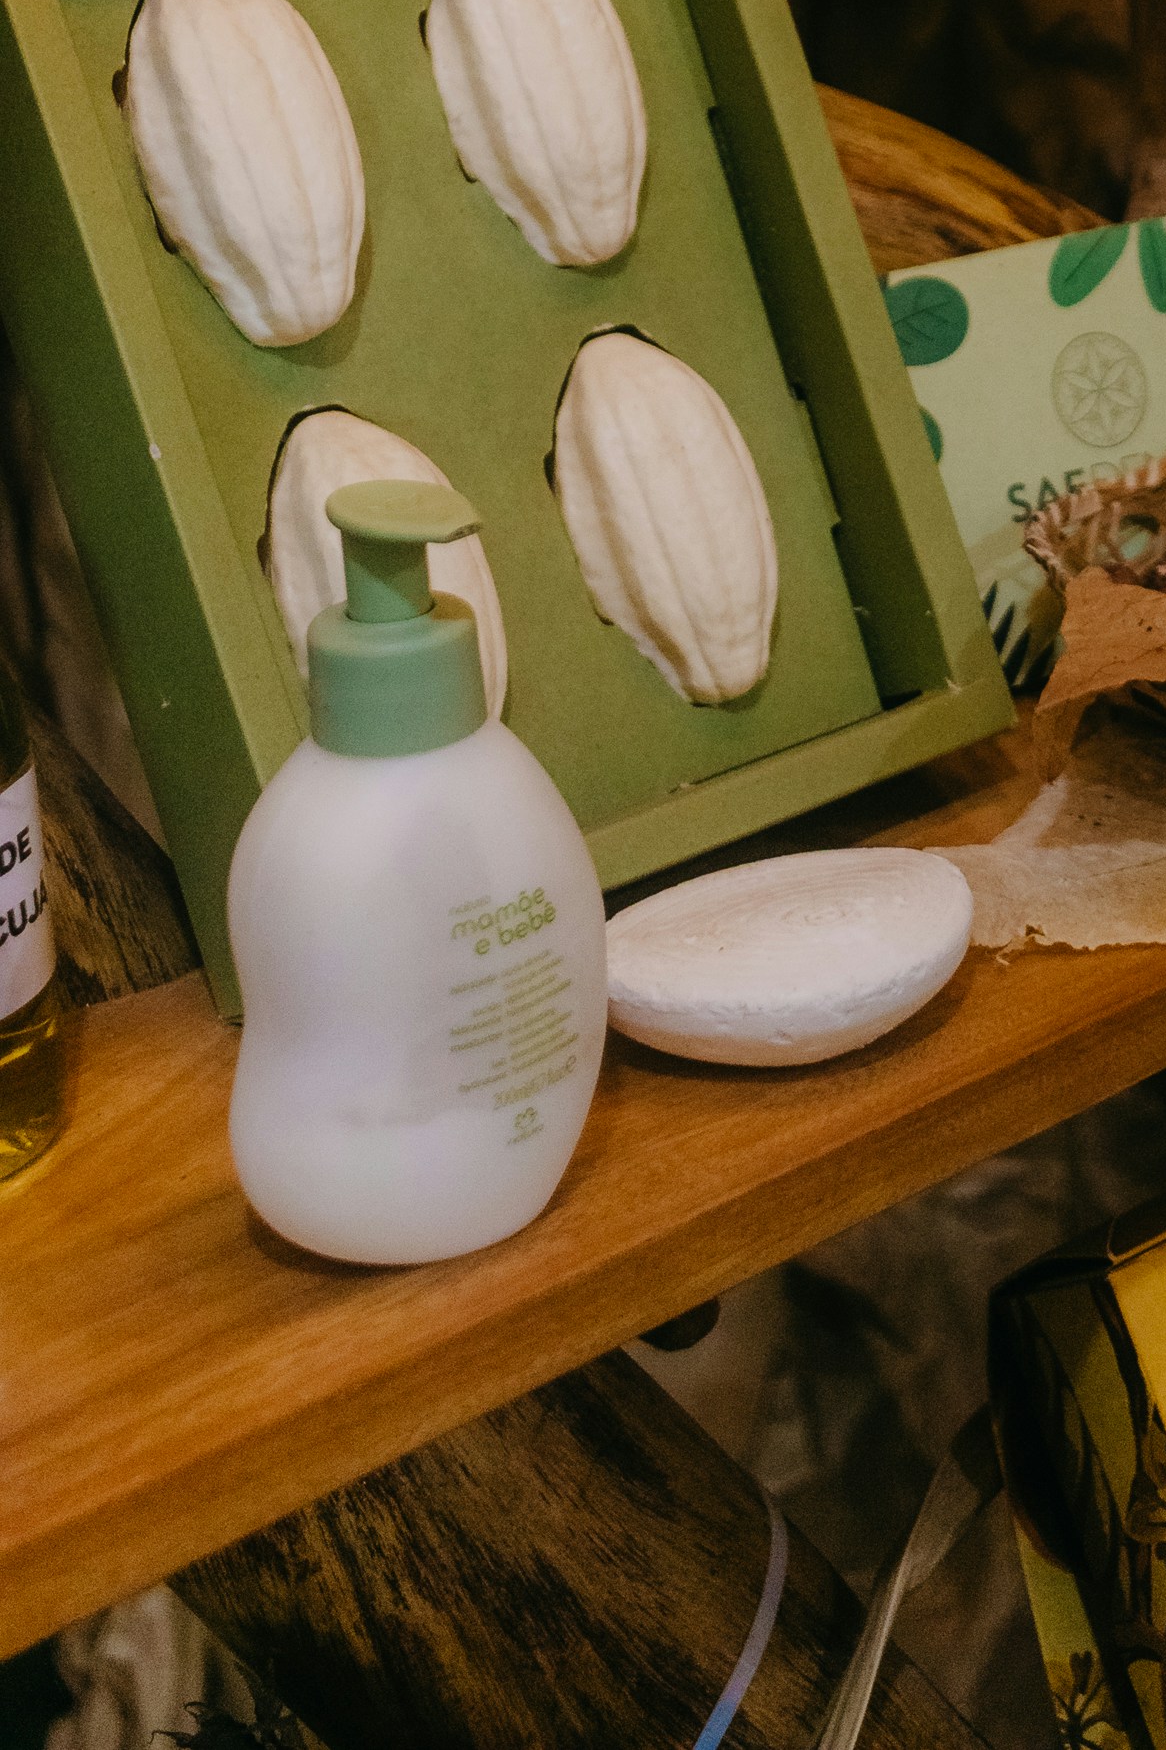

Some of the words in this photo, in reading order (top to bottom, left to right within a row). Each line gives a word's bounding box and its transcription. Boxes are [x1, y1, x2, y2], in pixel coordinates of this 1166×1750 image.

[450, 887, 545, 941] mamãe
[474, 938, 491, 956] e
[499, 901, 556, 946] bebê
